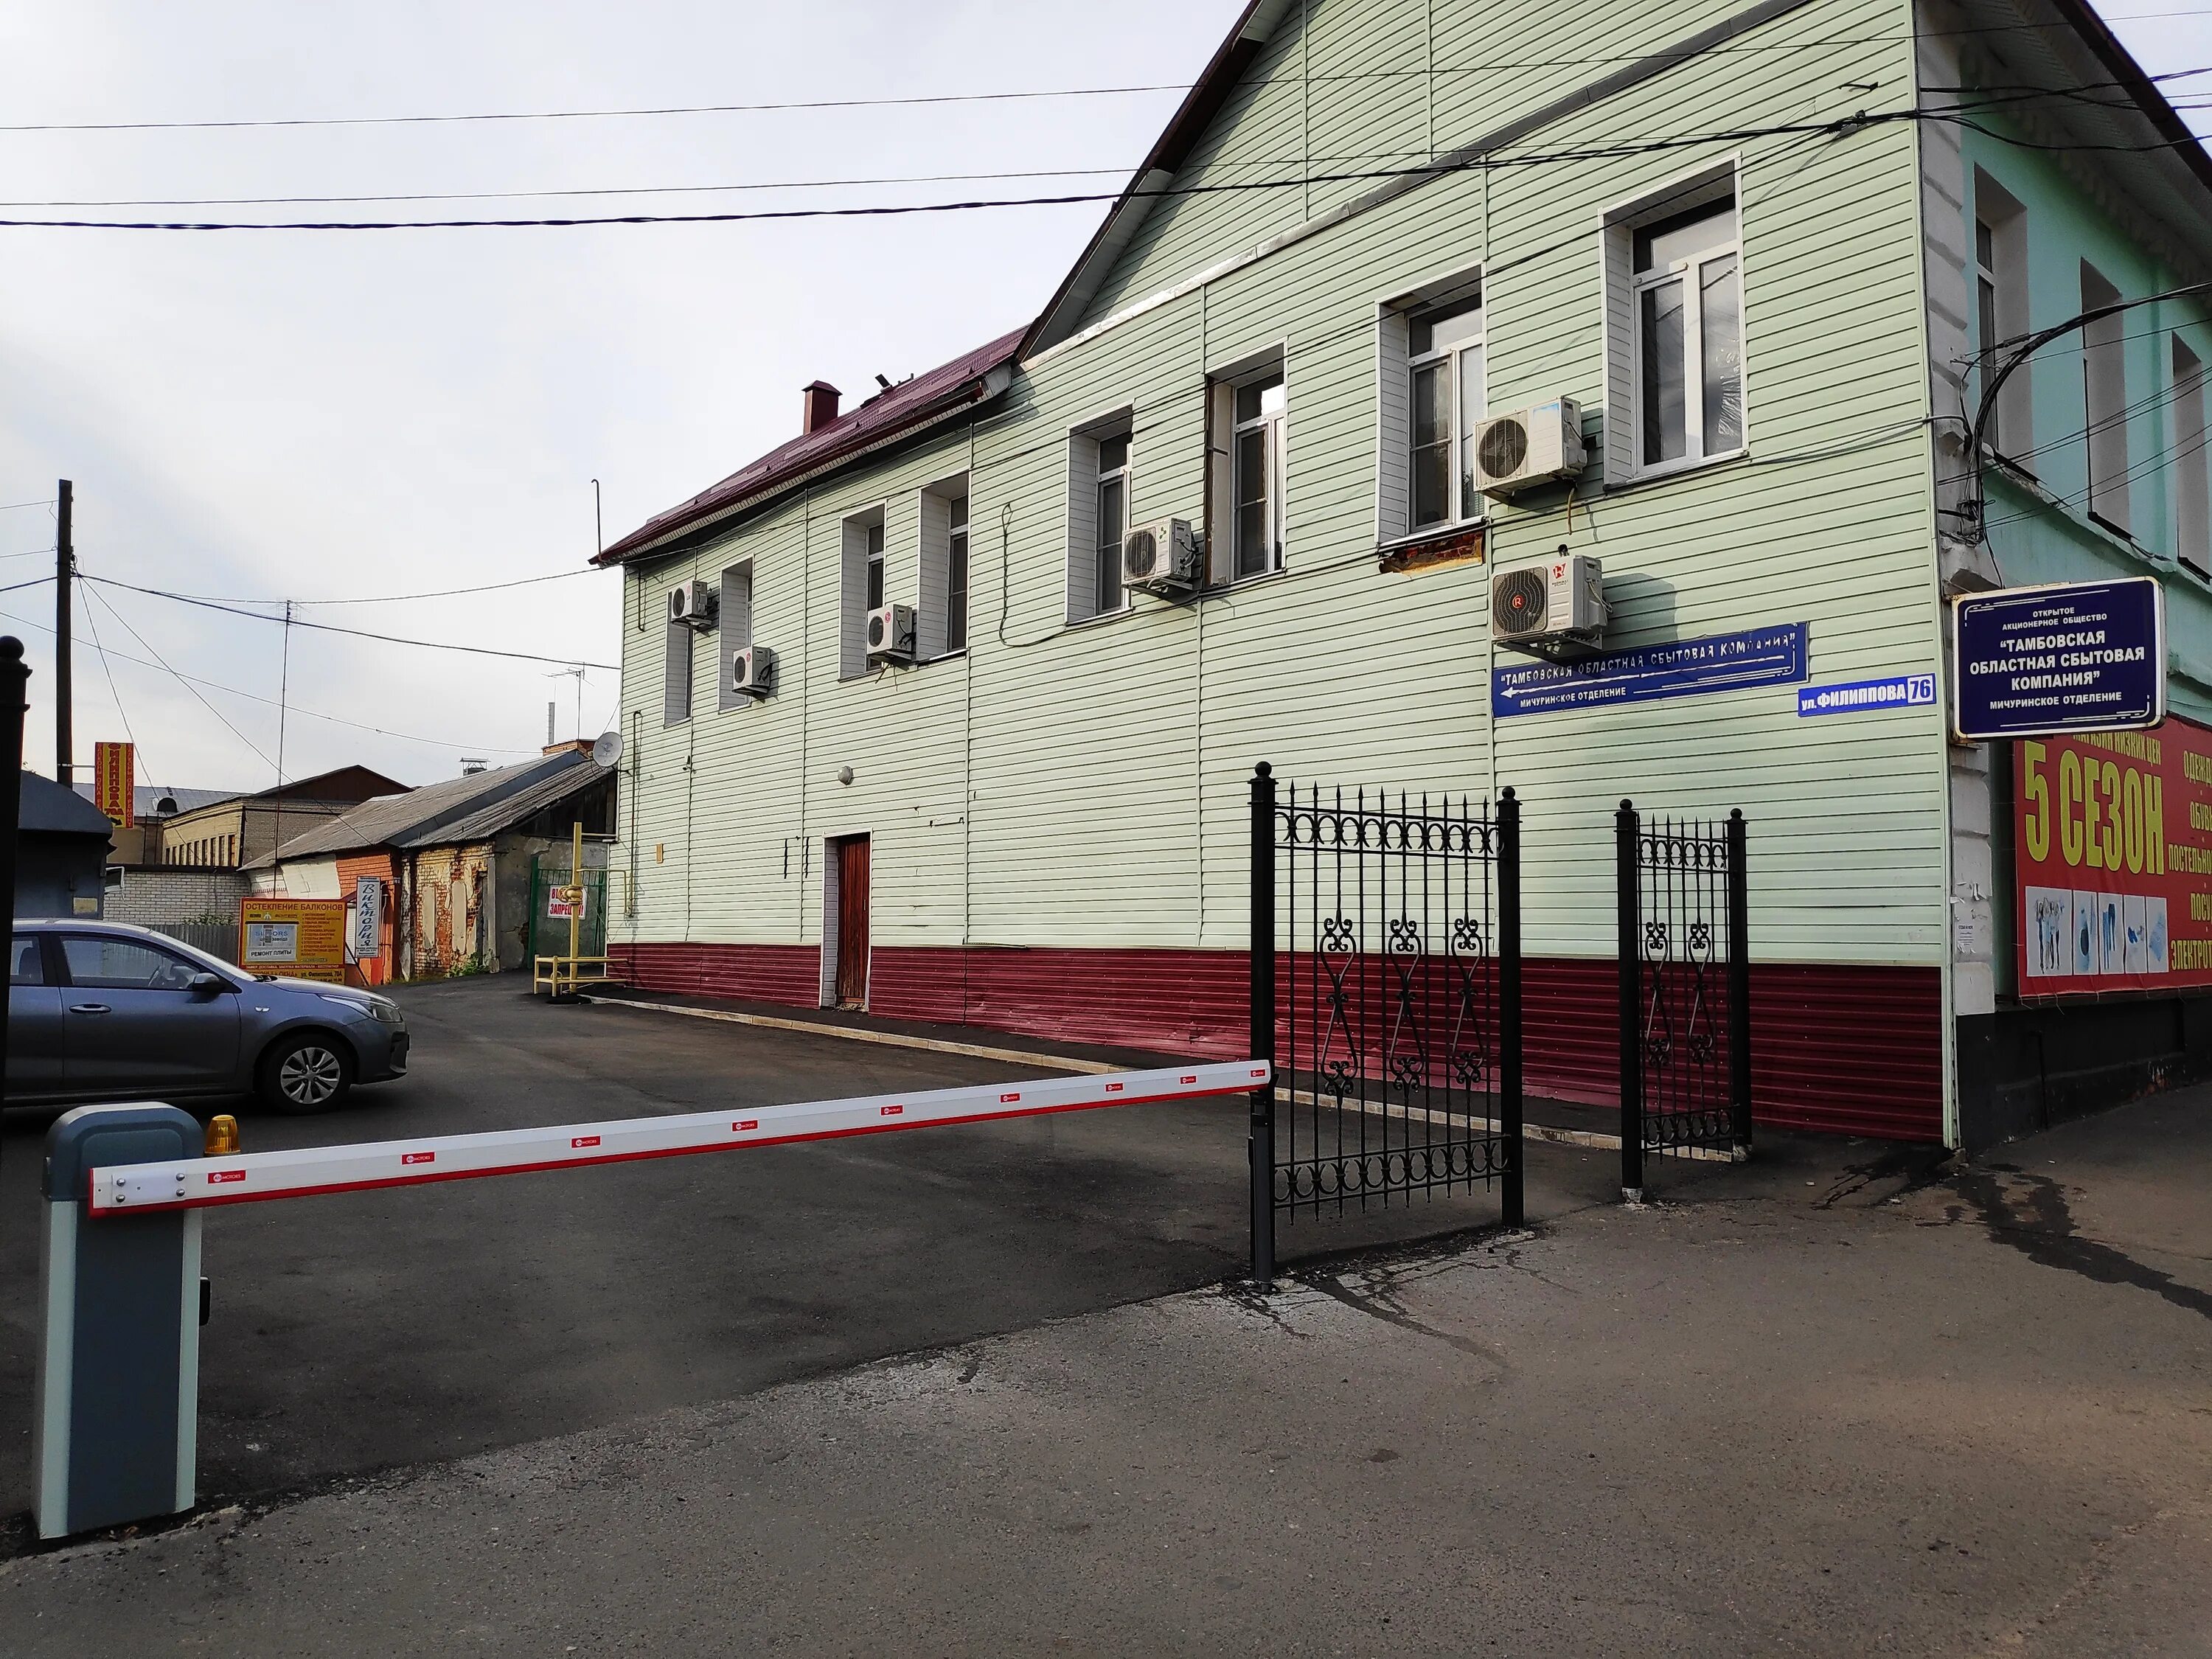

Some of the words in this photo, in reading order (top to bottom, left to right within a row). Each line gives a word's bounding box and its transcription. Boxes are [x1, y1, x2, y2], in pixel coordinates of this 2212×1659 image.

[2002, 618, 2059, 631] АКЦИОНЕРНОЕ
[2063, 613, 2107, 625] ОБЩЕСТВО
[2032, 607, 2075, 618] ОТКРЫТОЕ
[1578, 655, 1644, 675] ОБЛАСТНАЯ
[1651, 645, 1714, 665] СБЫТОВАЯ
[1969, 655, 2056, 675] ОБЛАСТНАЯ
[2060, 647, 2145, 665] СБЫТОВАЯ
[1520, 692, 1576, 708] МИЧУРИНСКОЕ
[1578, 686, 1627, 701] ОТДЕЛЕНИЕ
[1817, 684, 1906, 708] ФИЛИППОВА
[1910, 678, 1930, 700] 76
[1990, 696, 2059, 710] МИЧУРИНСКОЕ
[2063, 692, 2122, 705] ОТДЕЛЕНИЕ
[2146, 737, 2161, 767] ЦЕН
[108, 743, 121, 807] ФИЛИППОВА
[2183, 750, 2212, 788] ОДЕЖД
[2024, 740, 2050, 862] 5
[2059, 749, 2165, 875] СЕЗОН
[2168, 844, 2212, 875] ПОСТЕЛЬНО
[358, 884, 377, 947] Виктория
[2191, 893, 2212, 925] ПОСУ
